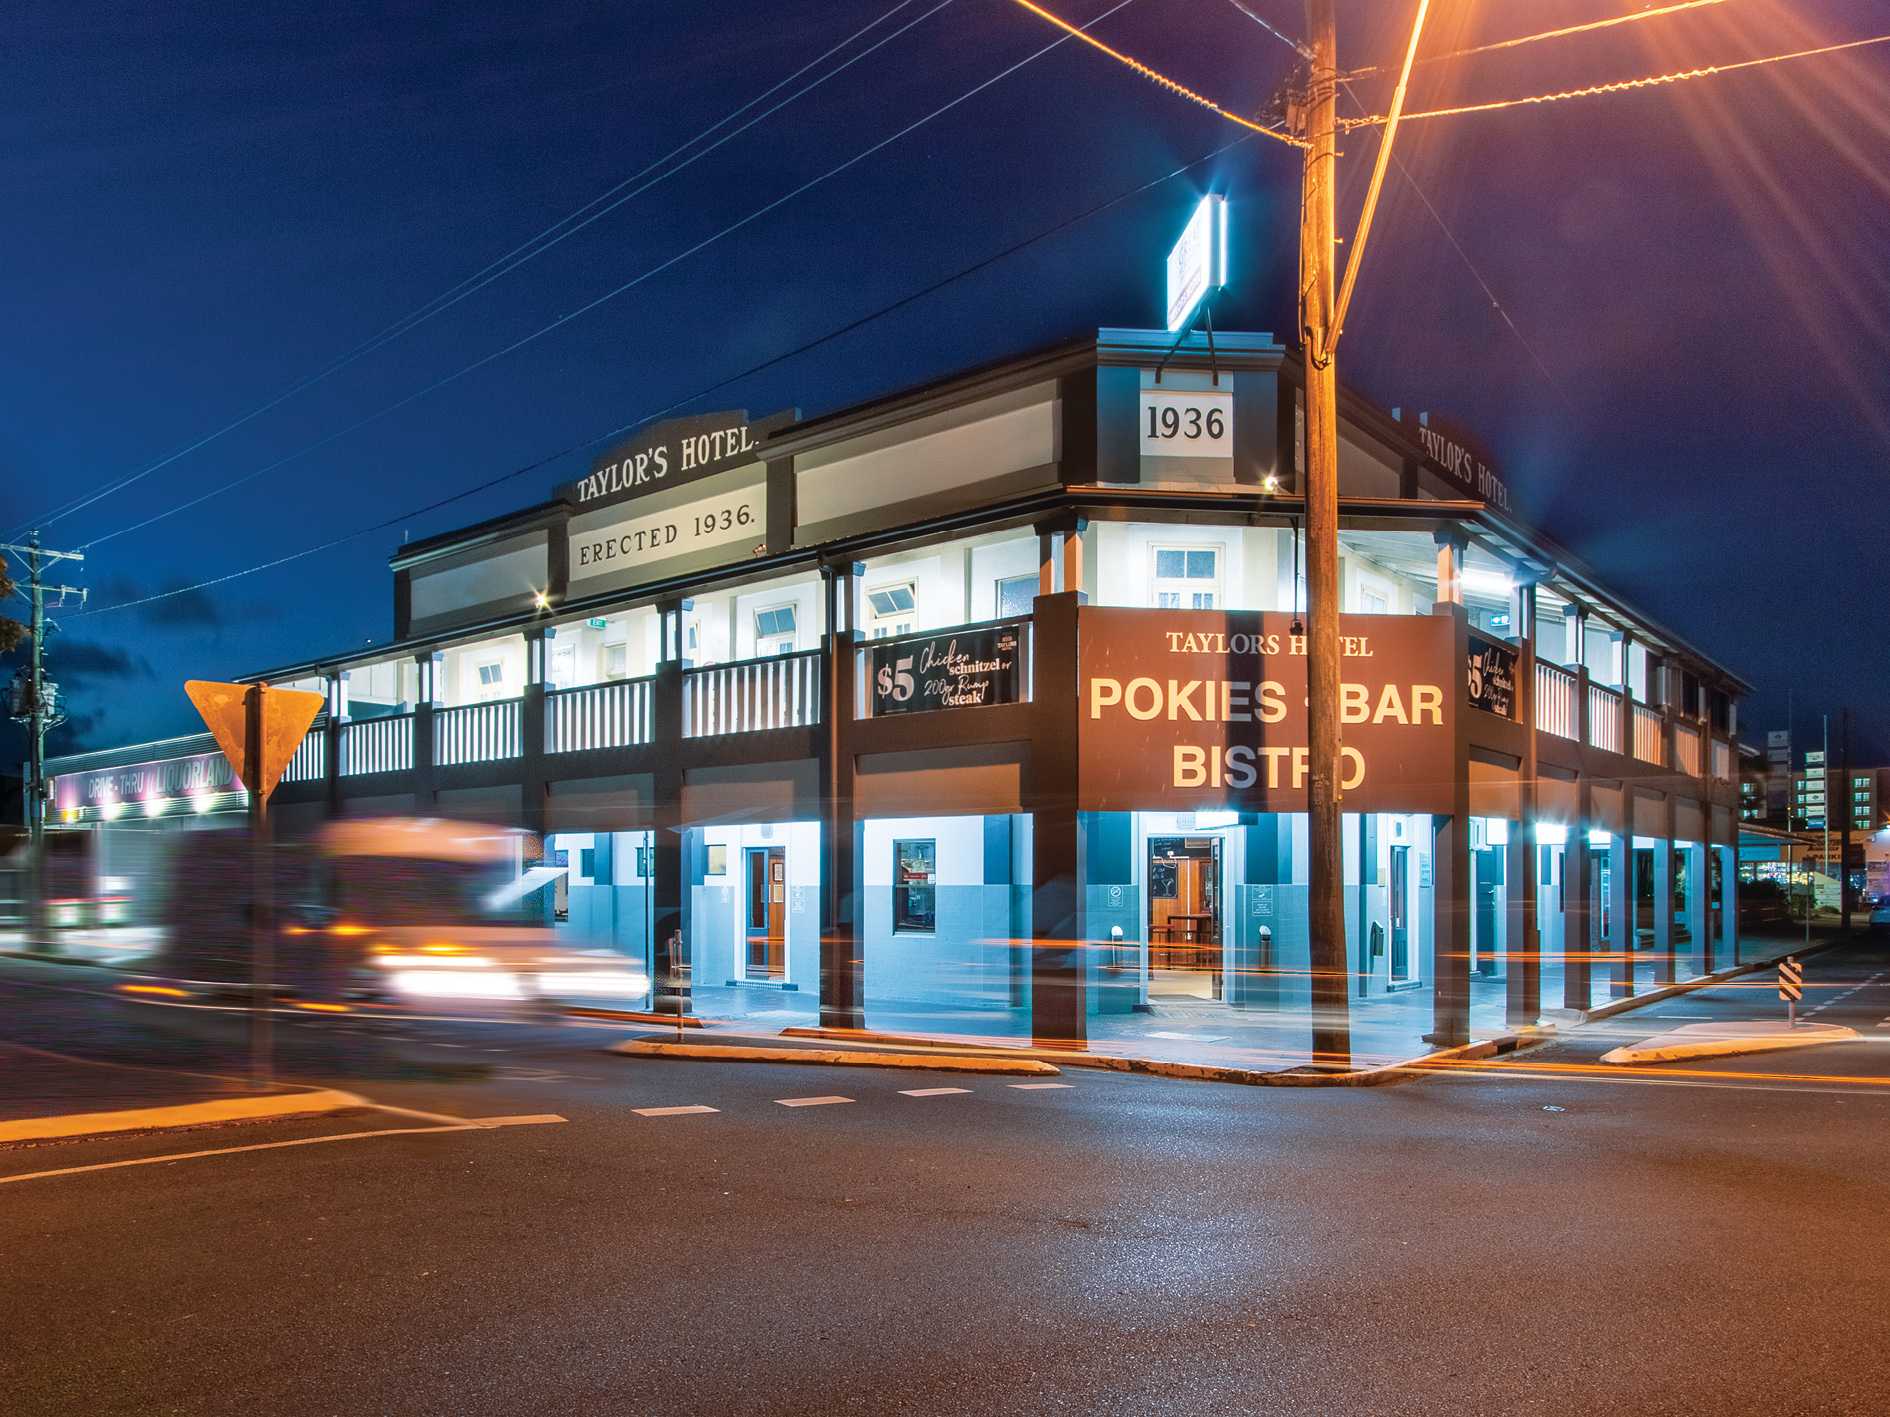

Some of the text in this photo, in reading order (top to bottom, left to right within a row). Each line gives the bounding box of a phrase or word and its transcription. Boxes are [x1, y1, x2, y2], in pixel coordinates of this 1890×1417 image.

[1147, 406, 1224, 440] 1936
[1419, 427, 1472, 484] TAYLOR'S
[577, 445, 668, 503] TAYLOR'S
[580, 524, 678, 565] ERECTED
[920, 640, 970, 673] Chicken
[1166, 631, 1374, 657] TAYLORS HEL
[877, 655, 915, 702] $5
[949, 658, 1001, 676] schnitzel
[958, 676, 990, 699] Rump
[949, 692, 982, 706] steak
[1090, 677, 1288, 724] POKIES
[1339, 683, 1444, 726] BAR
[157, 758, 232, 793] LIQUORLAND
